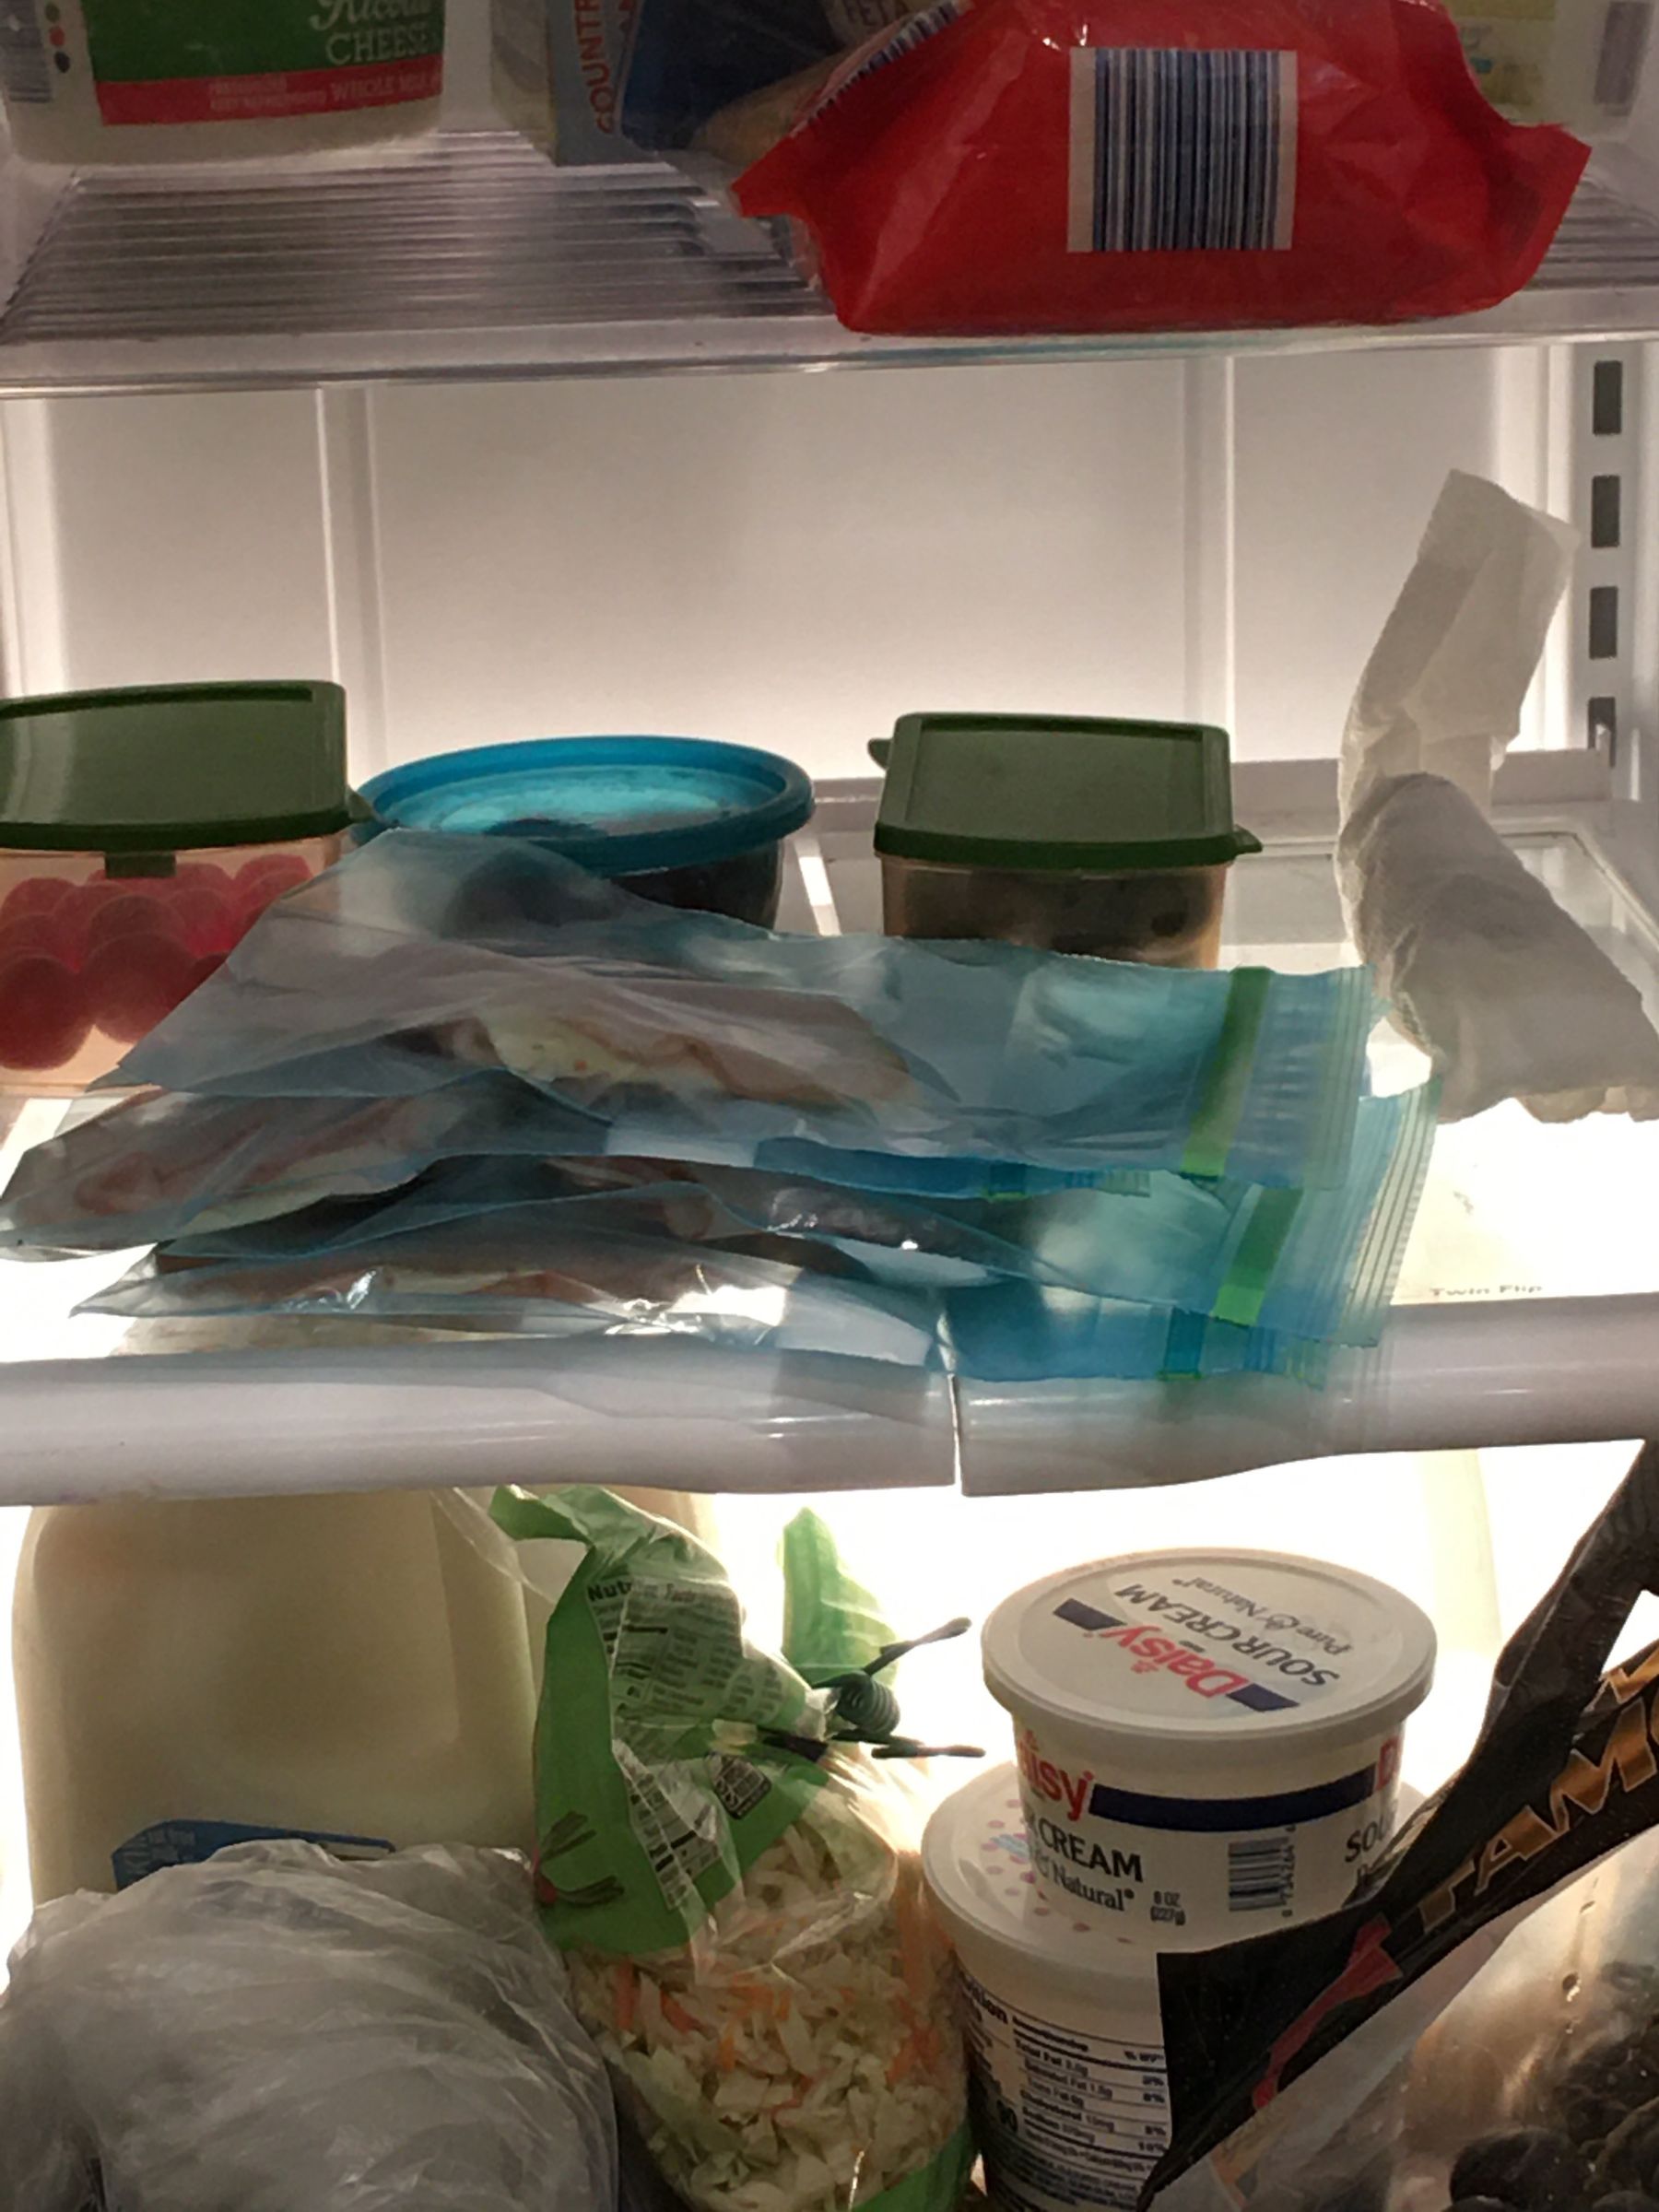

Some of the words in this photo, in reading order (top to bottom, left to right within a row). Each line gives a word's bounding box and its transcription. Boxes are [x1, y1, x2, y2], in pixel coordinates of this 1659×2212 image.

[1113, 1584, 1241, 1641] CREAM
[1296, 1624, 1353, 1655] Pure
[1099, 1625, 1249, 1698] Daisy
[1231, 1635, 1340, 1686] SOUR
[1018, 1731, 1090, 1821] aisy
[1038, 1817, 1143, 1883] CREAM
[1052, 1860, 1124, 1912] Natural
[1163, 1891, 1182, 1908] OZ
